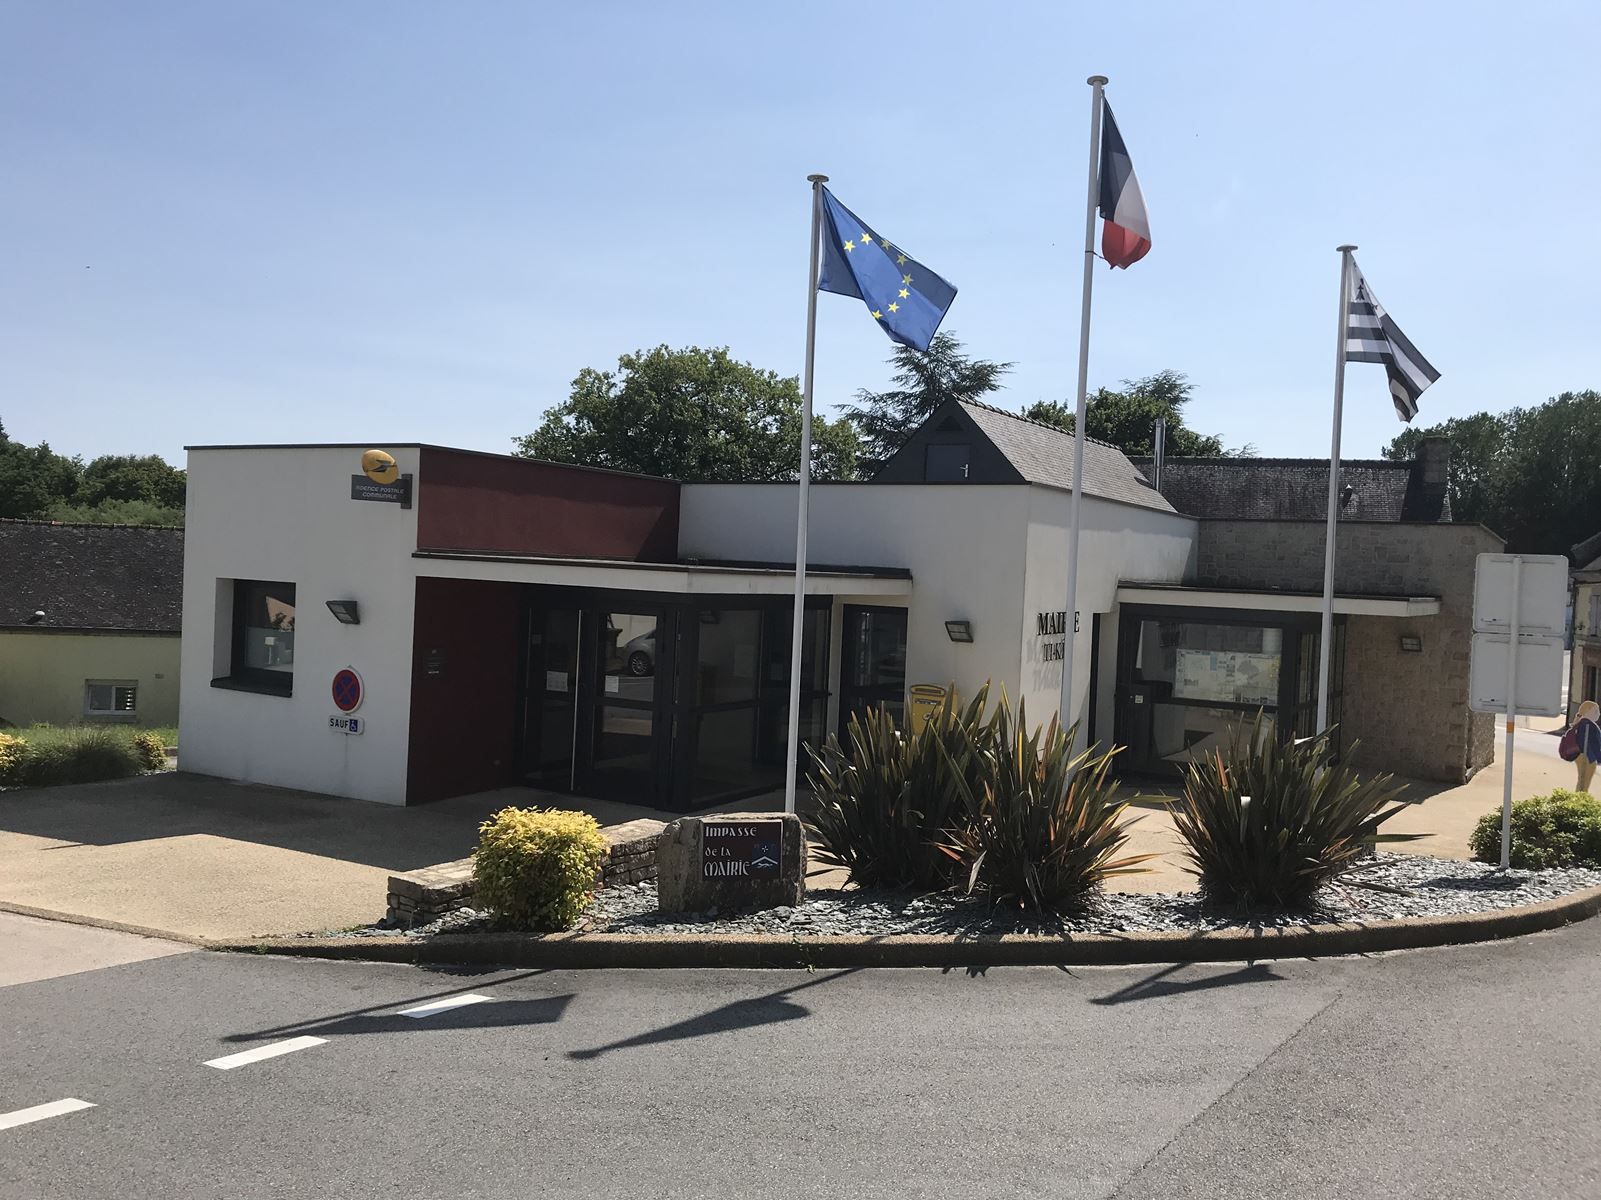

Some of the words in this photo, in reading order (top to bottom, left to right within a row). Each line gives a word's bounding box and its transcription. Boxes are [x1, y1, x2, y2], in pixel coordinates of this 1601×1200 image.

[380, 487, 405, 495] POSTALE
[1037, 611, 1080, 636] MAIE
[330, 718, 349, 729] SAUF
[705, 846, 718, 857] de
[704, 859, 750, 877] MAIRIE
